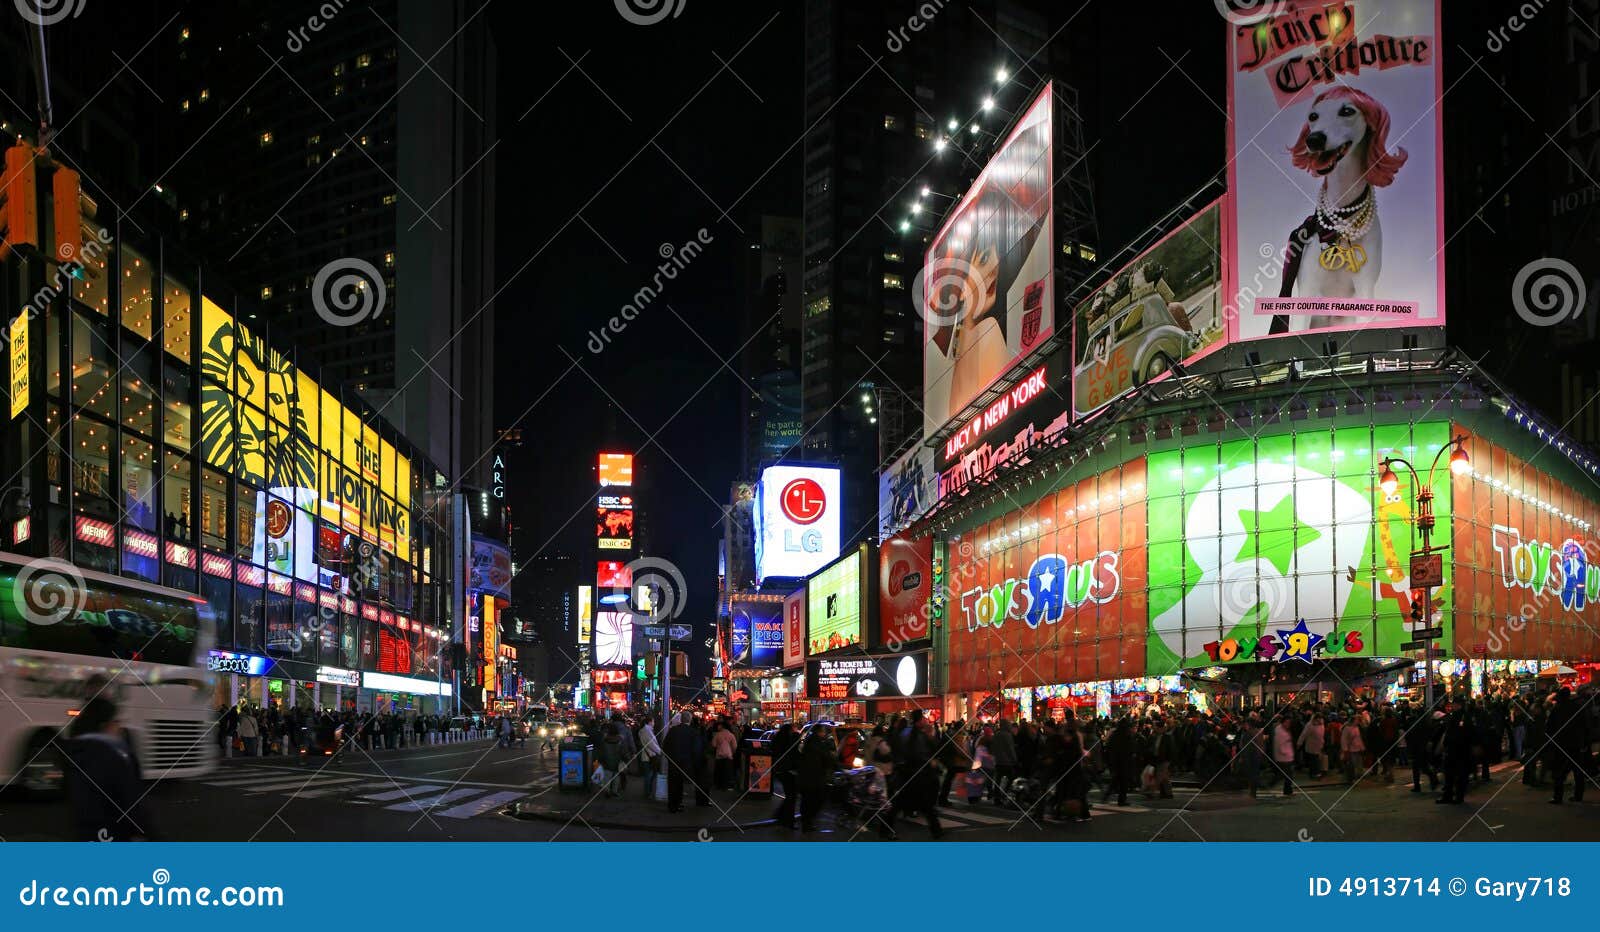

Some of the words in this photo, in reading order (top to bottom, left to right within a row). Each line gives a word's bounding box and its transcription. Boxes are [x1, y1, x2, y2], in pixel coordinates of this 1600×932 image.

[1260, 302, 1274, 310] THE
[1275, 302, 1295, 310] FIRST
[1297, 302, 1330, 311] COUTURE
[1330, 303, 1374, 312] FRAGRANCE
[1375, 304, 1390, 313] FOR
[1392, 305, 1412, 314] DOGS
[14, 331, 25, 351] THE
[12, 350, 27, 380] LION
[13, 374, 28, 406] KING
[945, 427, 971, 460] JUICY
[984, 396, 1009, 431] NEW
[1011, 367, 1047, 409] YORK
[777, 421, 794, 430] part
[354, 438, 379, 473] THE
[327, 449, 368, 513] LION
[370, 480, 405, 536] KING
[598, 496, 620, 505] HSBC
[82, 524, 108, 539] MERRY
[784, 529, 823, 552] LG
[123, 535, 158, 553] WHATEVER
[1204, 635, 1278, 662] TOYS
[1325, 630, 1364, 654] US
[824, 667, 856, 675] BROADWAY
[864, 660, 873, 668] TO
